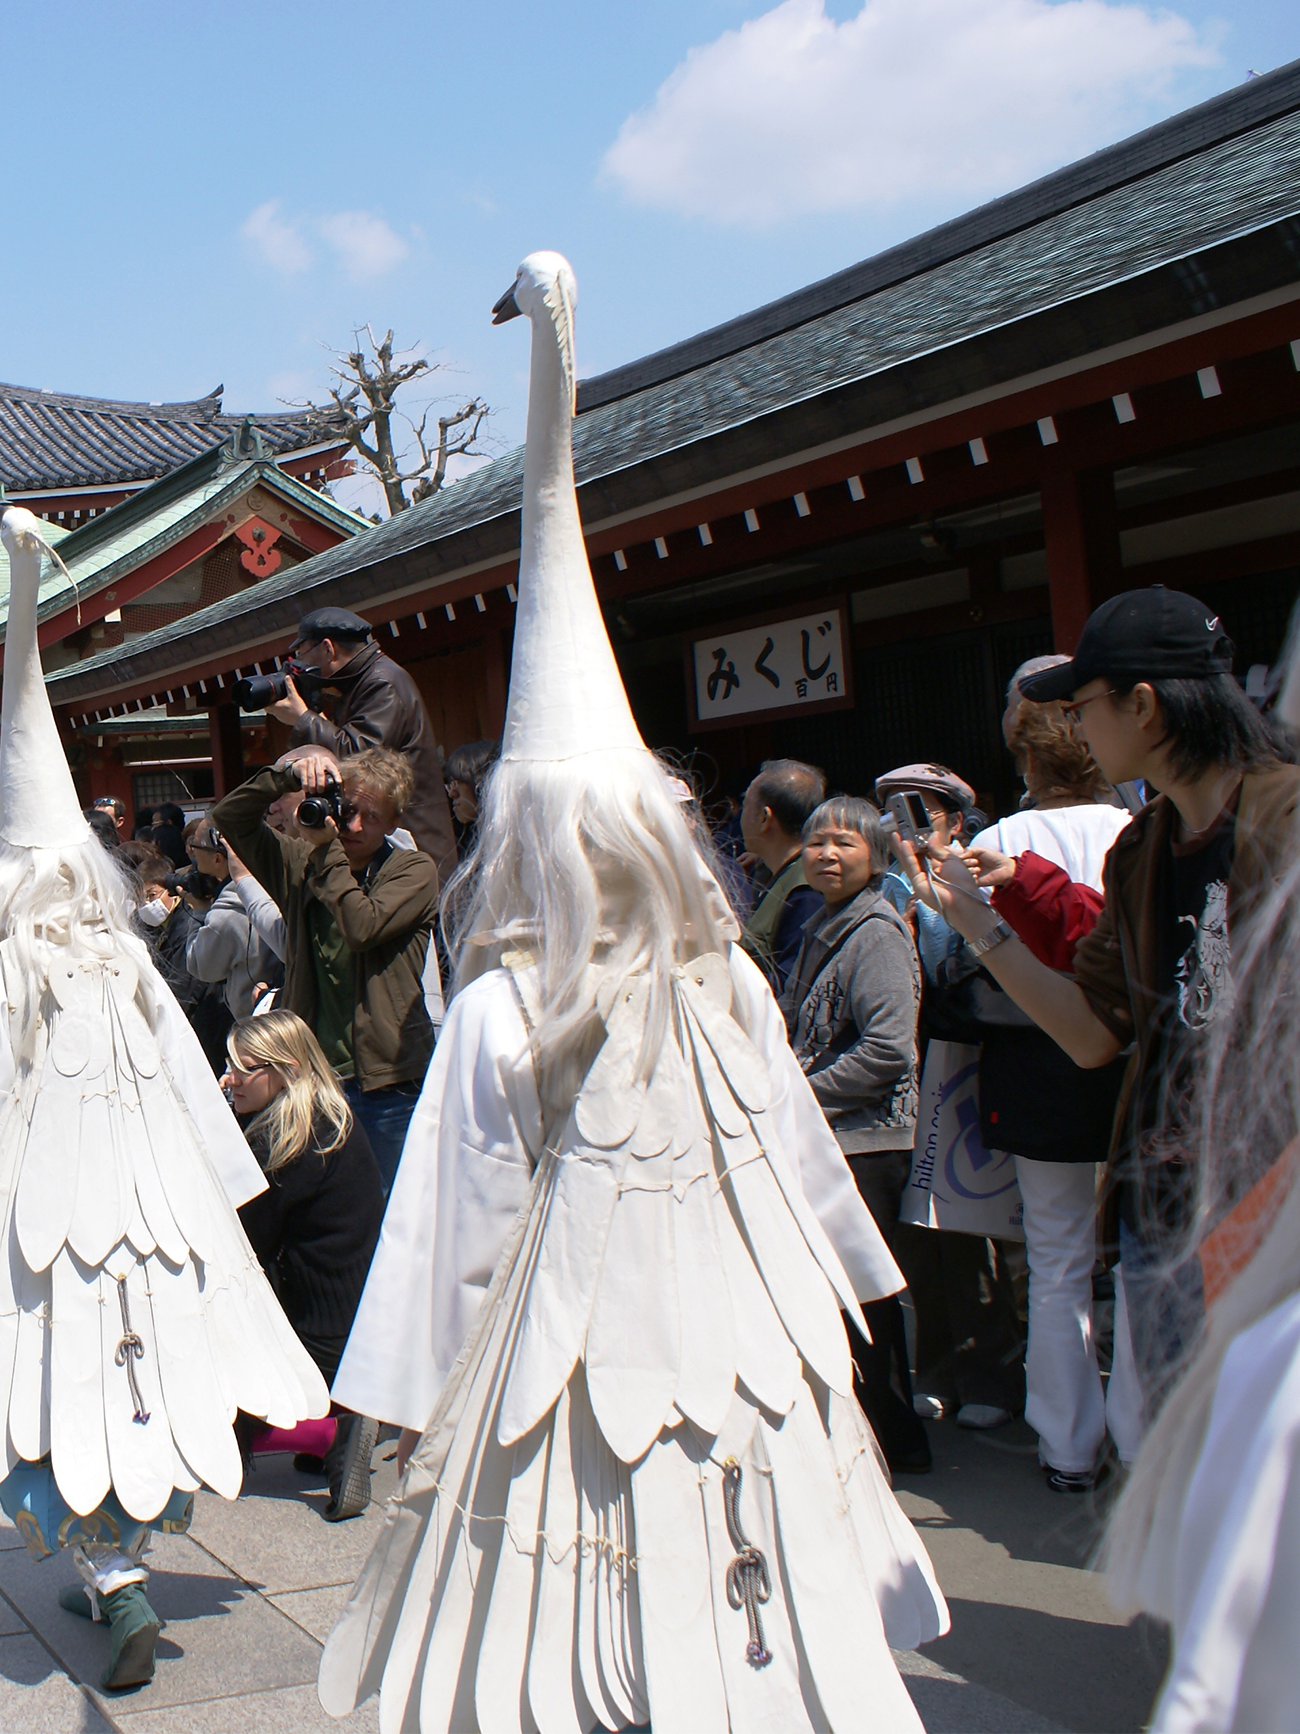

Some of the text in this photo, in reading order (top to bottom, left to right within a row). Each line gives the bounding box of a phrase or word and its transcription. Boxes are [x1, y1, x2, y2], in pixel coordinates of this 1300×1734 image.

[707, 620, 832, 701] みくじ
[795, 672, 837, 698] 百円
[912, 1082, 943, 1190] hilton
